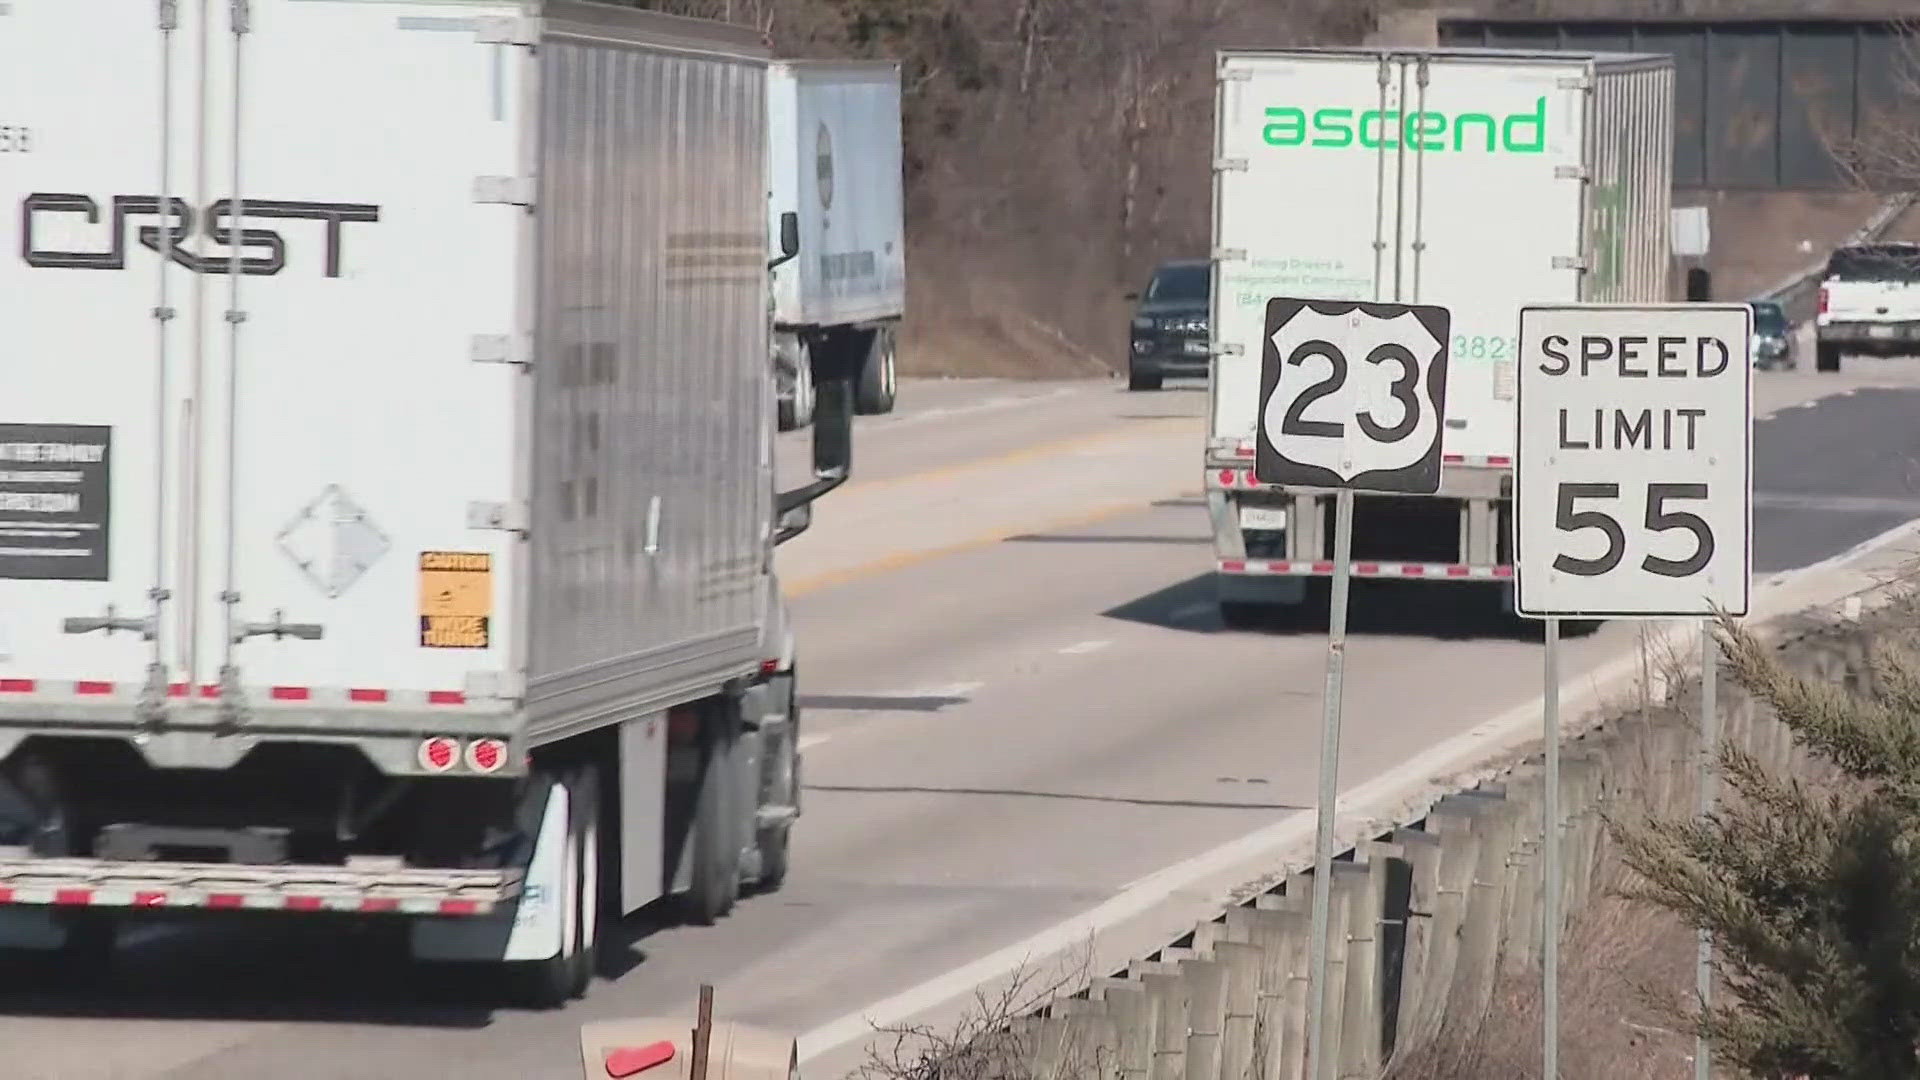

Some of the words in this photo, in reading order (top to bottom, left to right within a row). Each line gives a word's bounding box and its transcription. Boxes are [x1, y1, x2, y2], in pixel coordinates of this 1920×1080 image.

[1263, 96, 1547, 152] ascend
[23, 192, 379, 277] CRST
[1281, 338, 1421, 444] 23
[1538, 335, 1729, 377] SPEED
[1559, 408, 1706, 450] LIMIT
[1551, 482, 1715, 577] 55
